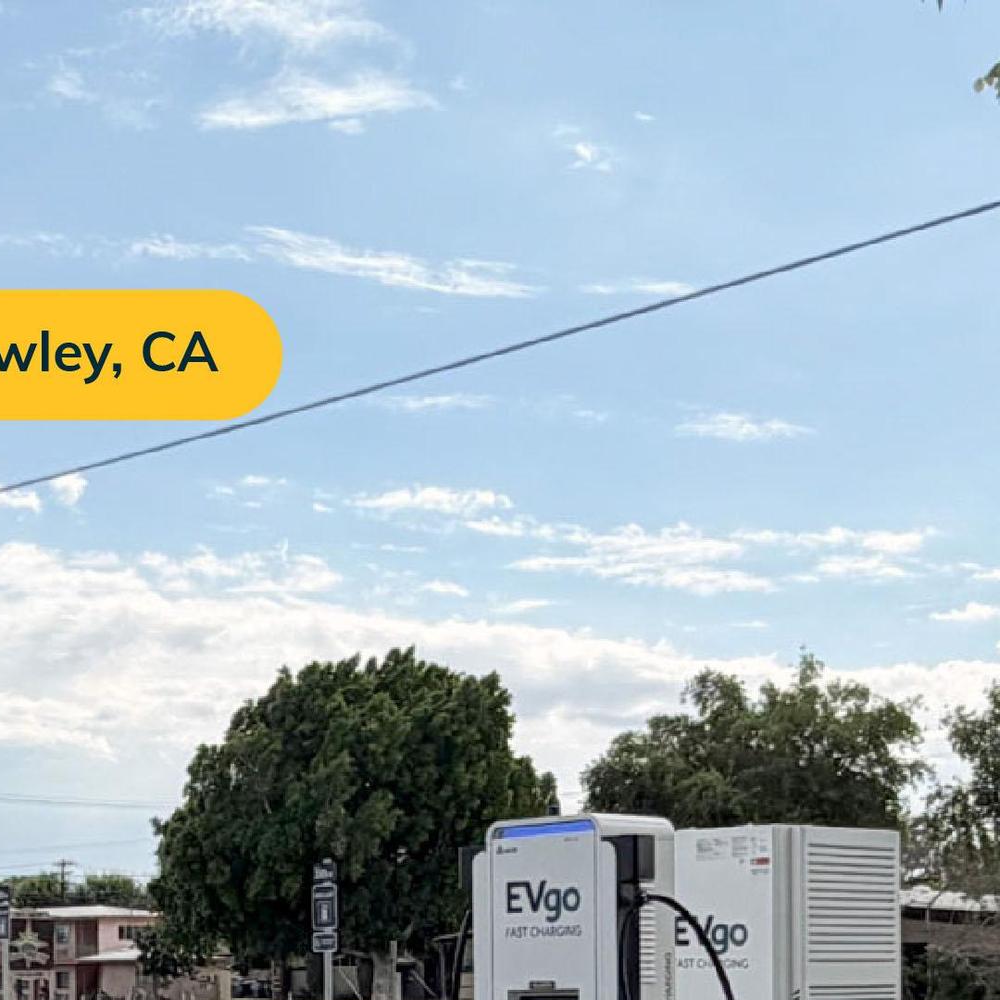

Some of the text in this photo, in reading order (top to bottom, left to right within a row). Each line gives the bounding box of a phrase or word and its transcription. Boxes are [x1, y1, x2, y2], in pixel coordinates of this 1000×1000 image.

[507, 880, 581, 922] EVgo
[505, 926, 527, 938] FAST
[675, 915, 749, 955] EVgo
[676, 958, 695, 969] AST
